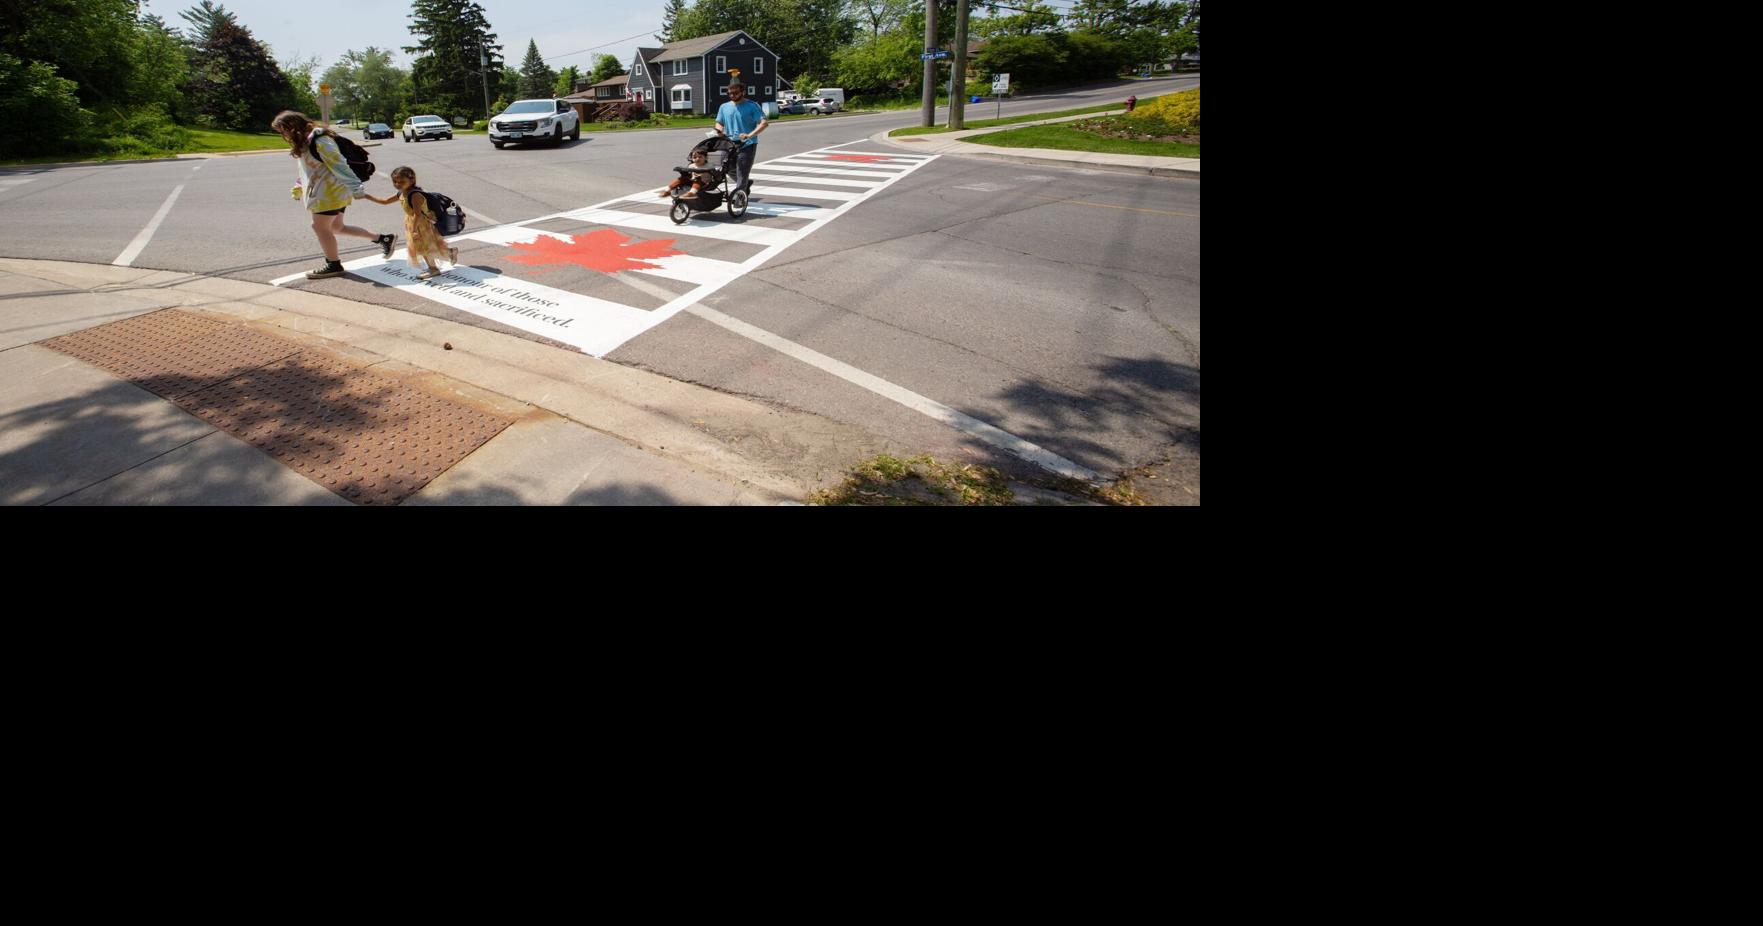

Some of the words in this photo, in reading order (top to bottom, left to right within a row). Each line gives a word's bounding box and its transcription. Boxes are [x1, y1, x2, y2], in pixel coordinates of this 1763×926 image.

[379, 266, 408, 278] who
[450, 289, 487, 301] and
[481, 299, 575, 328] sacrificed.
[491, 287, 517, 295] of
[510, 292, 559, 307] those
